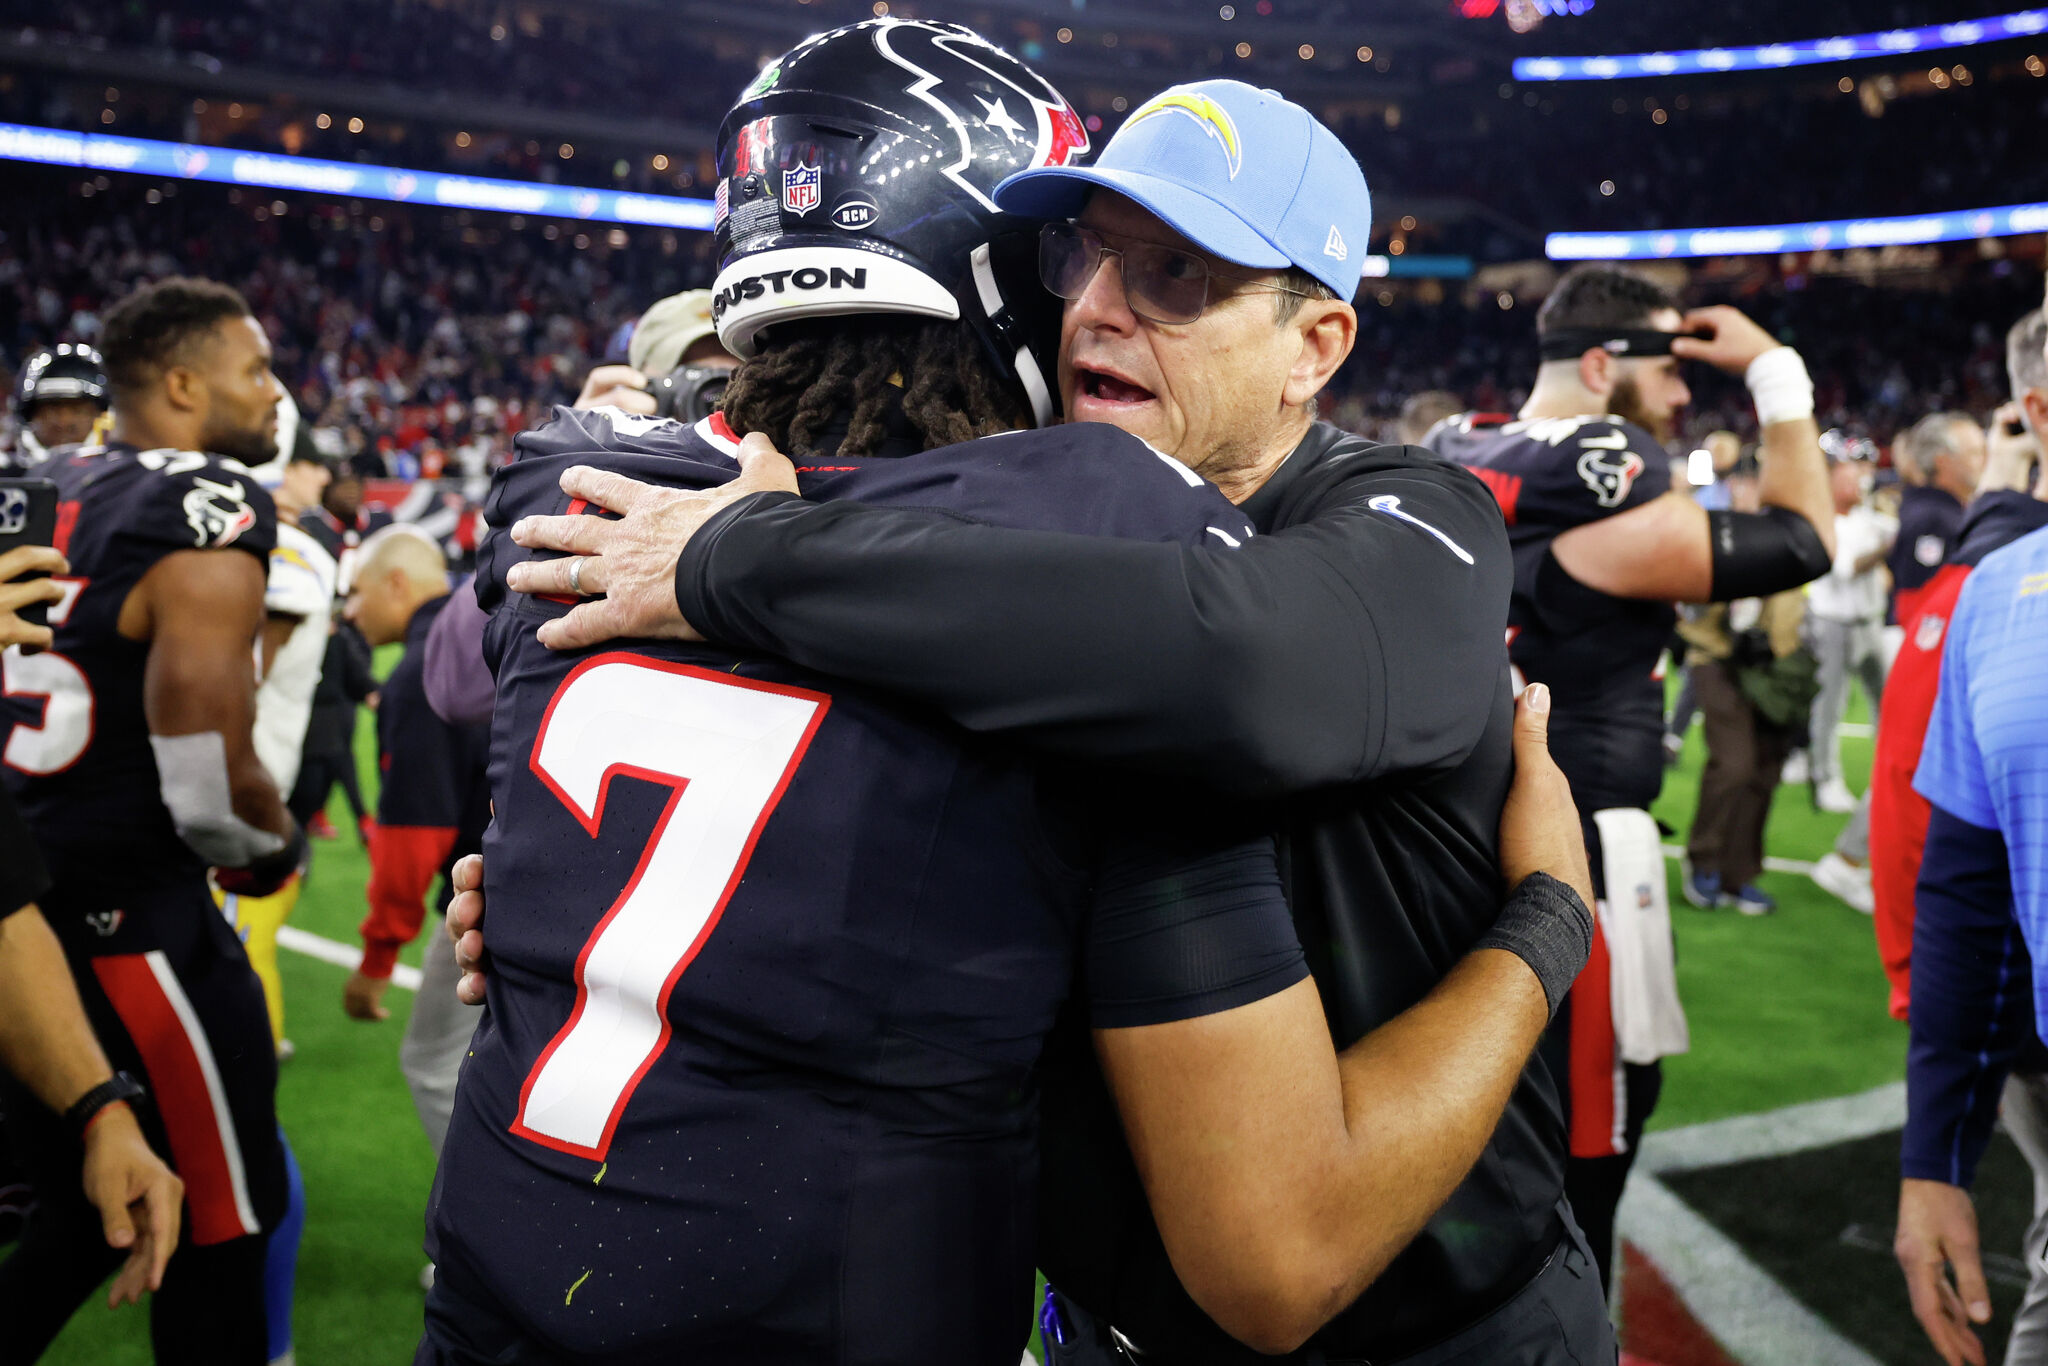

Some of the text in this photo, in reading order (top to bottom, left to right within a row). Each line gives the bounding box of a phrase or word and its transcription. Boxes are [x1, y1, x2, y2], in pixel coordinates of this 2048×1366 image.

[788, 185, 816, 207] NFL
[842, 208, 868, 223] RCM
[711, 267, 867, 330] OUSTON
[509, 651, 832, 1163] 7
